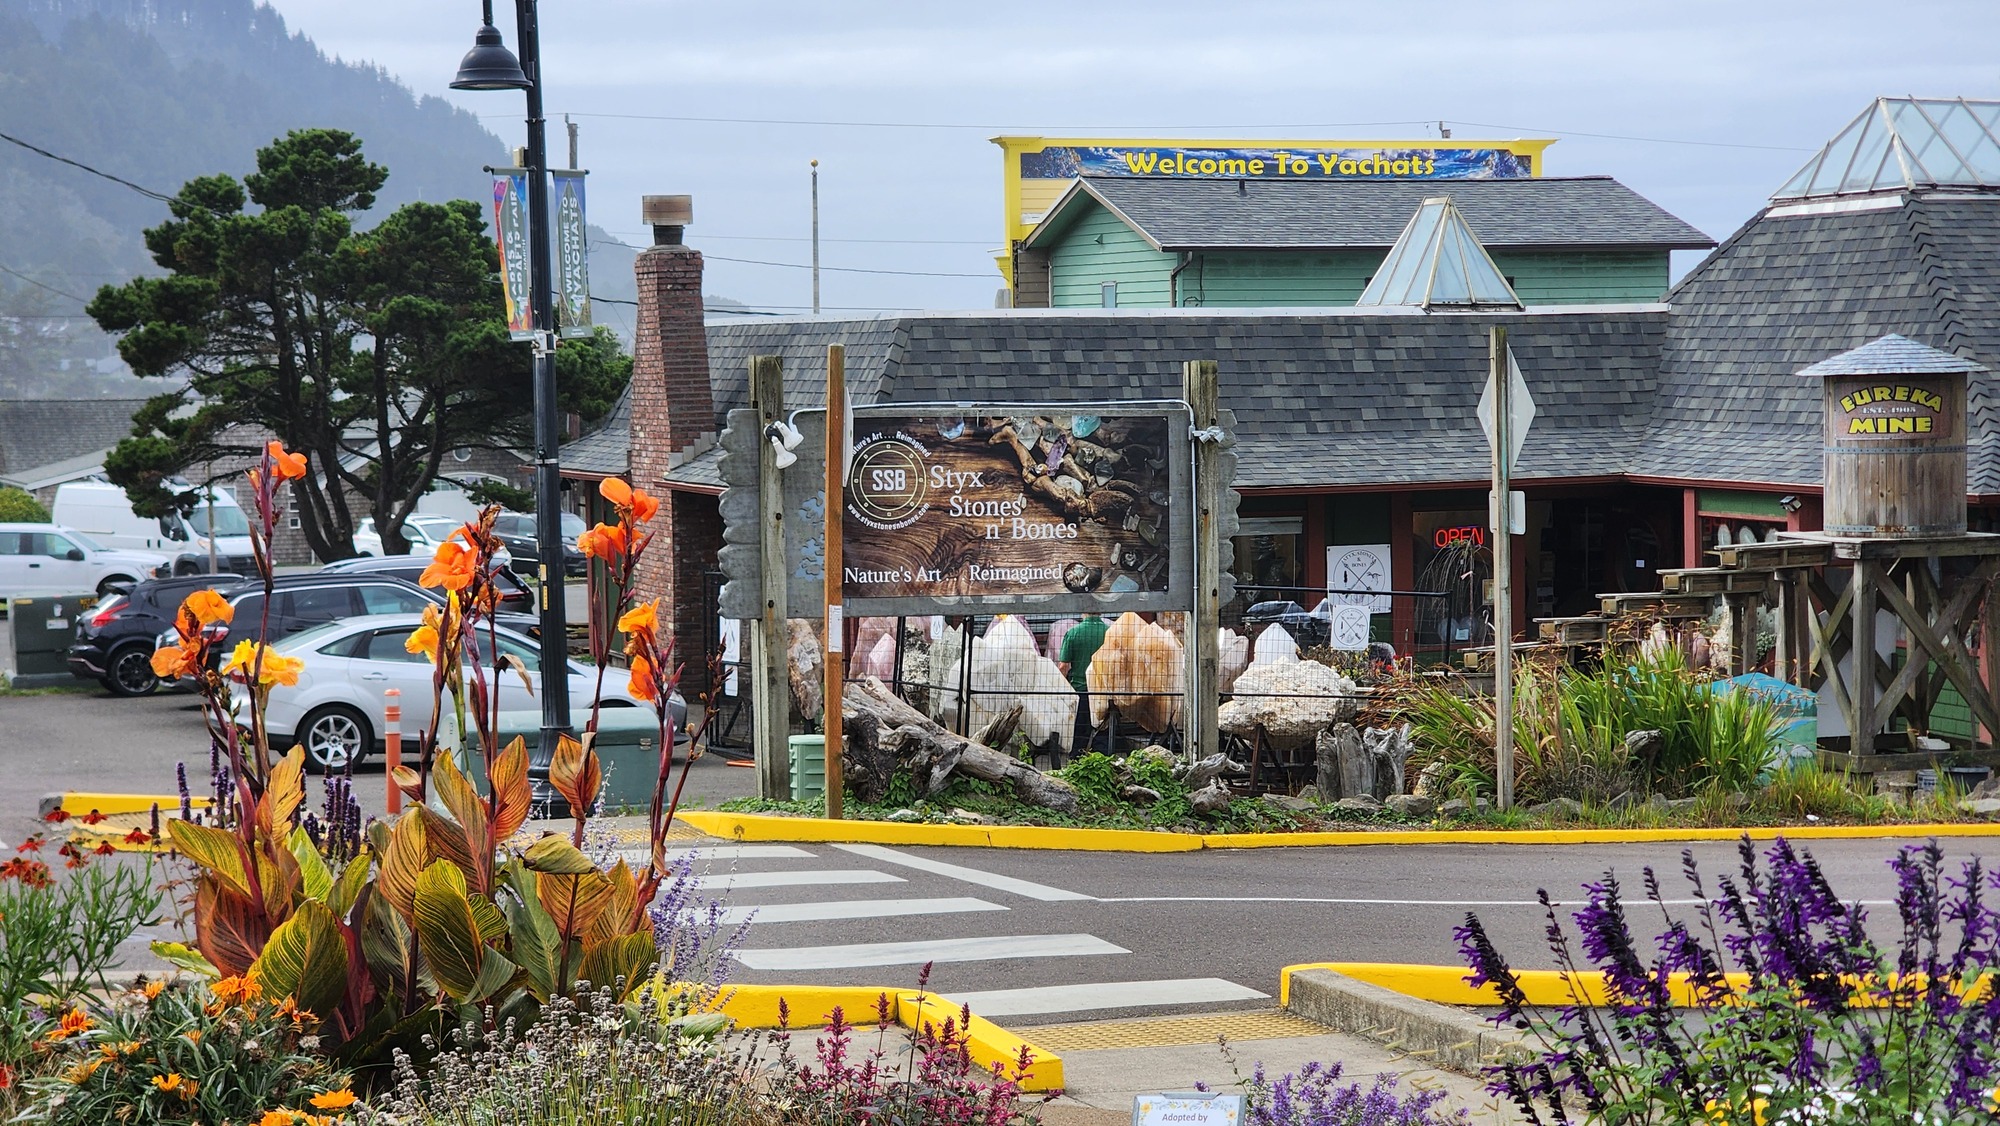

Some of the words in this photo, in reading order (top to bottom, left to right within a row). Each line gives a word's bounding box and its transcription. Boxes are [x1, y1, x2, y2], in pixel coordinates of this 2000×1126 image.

[1126, 151, 1265, 175] Welcome
[1272, 152, 1308, 175] To
[1317, 152, 1435, 175] Yachats
[562, 196, 569, 217] TO
[570, 197, 582, 293] YACHATS
[563, 222, 573, 293] WELCOME
[1840, 385, 1943, 413] EUREKA
[1848, 416, 1933, 434] MINE
[852, 436, 872, 457] ature's
[872, 432, 883, 441] Art
[896, 430, 932, 458] Reimagined
[872, 469, 906, 491] SSB
[930, 465, 984, 494] Styx
[847, 502, 930, 530] www.styxstonesnbones.com
[949, 495, 1022, 517] Stones
[1011, 517, 1078, 540] Bones
[1435, 527, 1484, 547] OPEN
[844, 566, 912, 584] Nature's
[916, 566, 942, 582] Art
[969, 563, 1063, 584] Reimagined
[1162, 1113, 1196, 1122] Adopted
[1198, 1113, 1208, 1123] by
